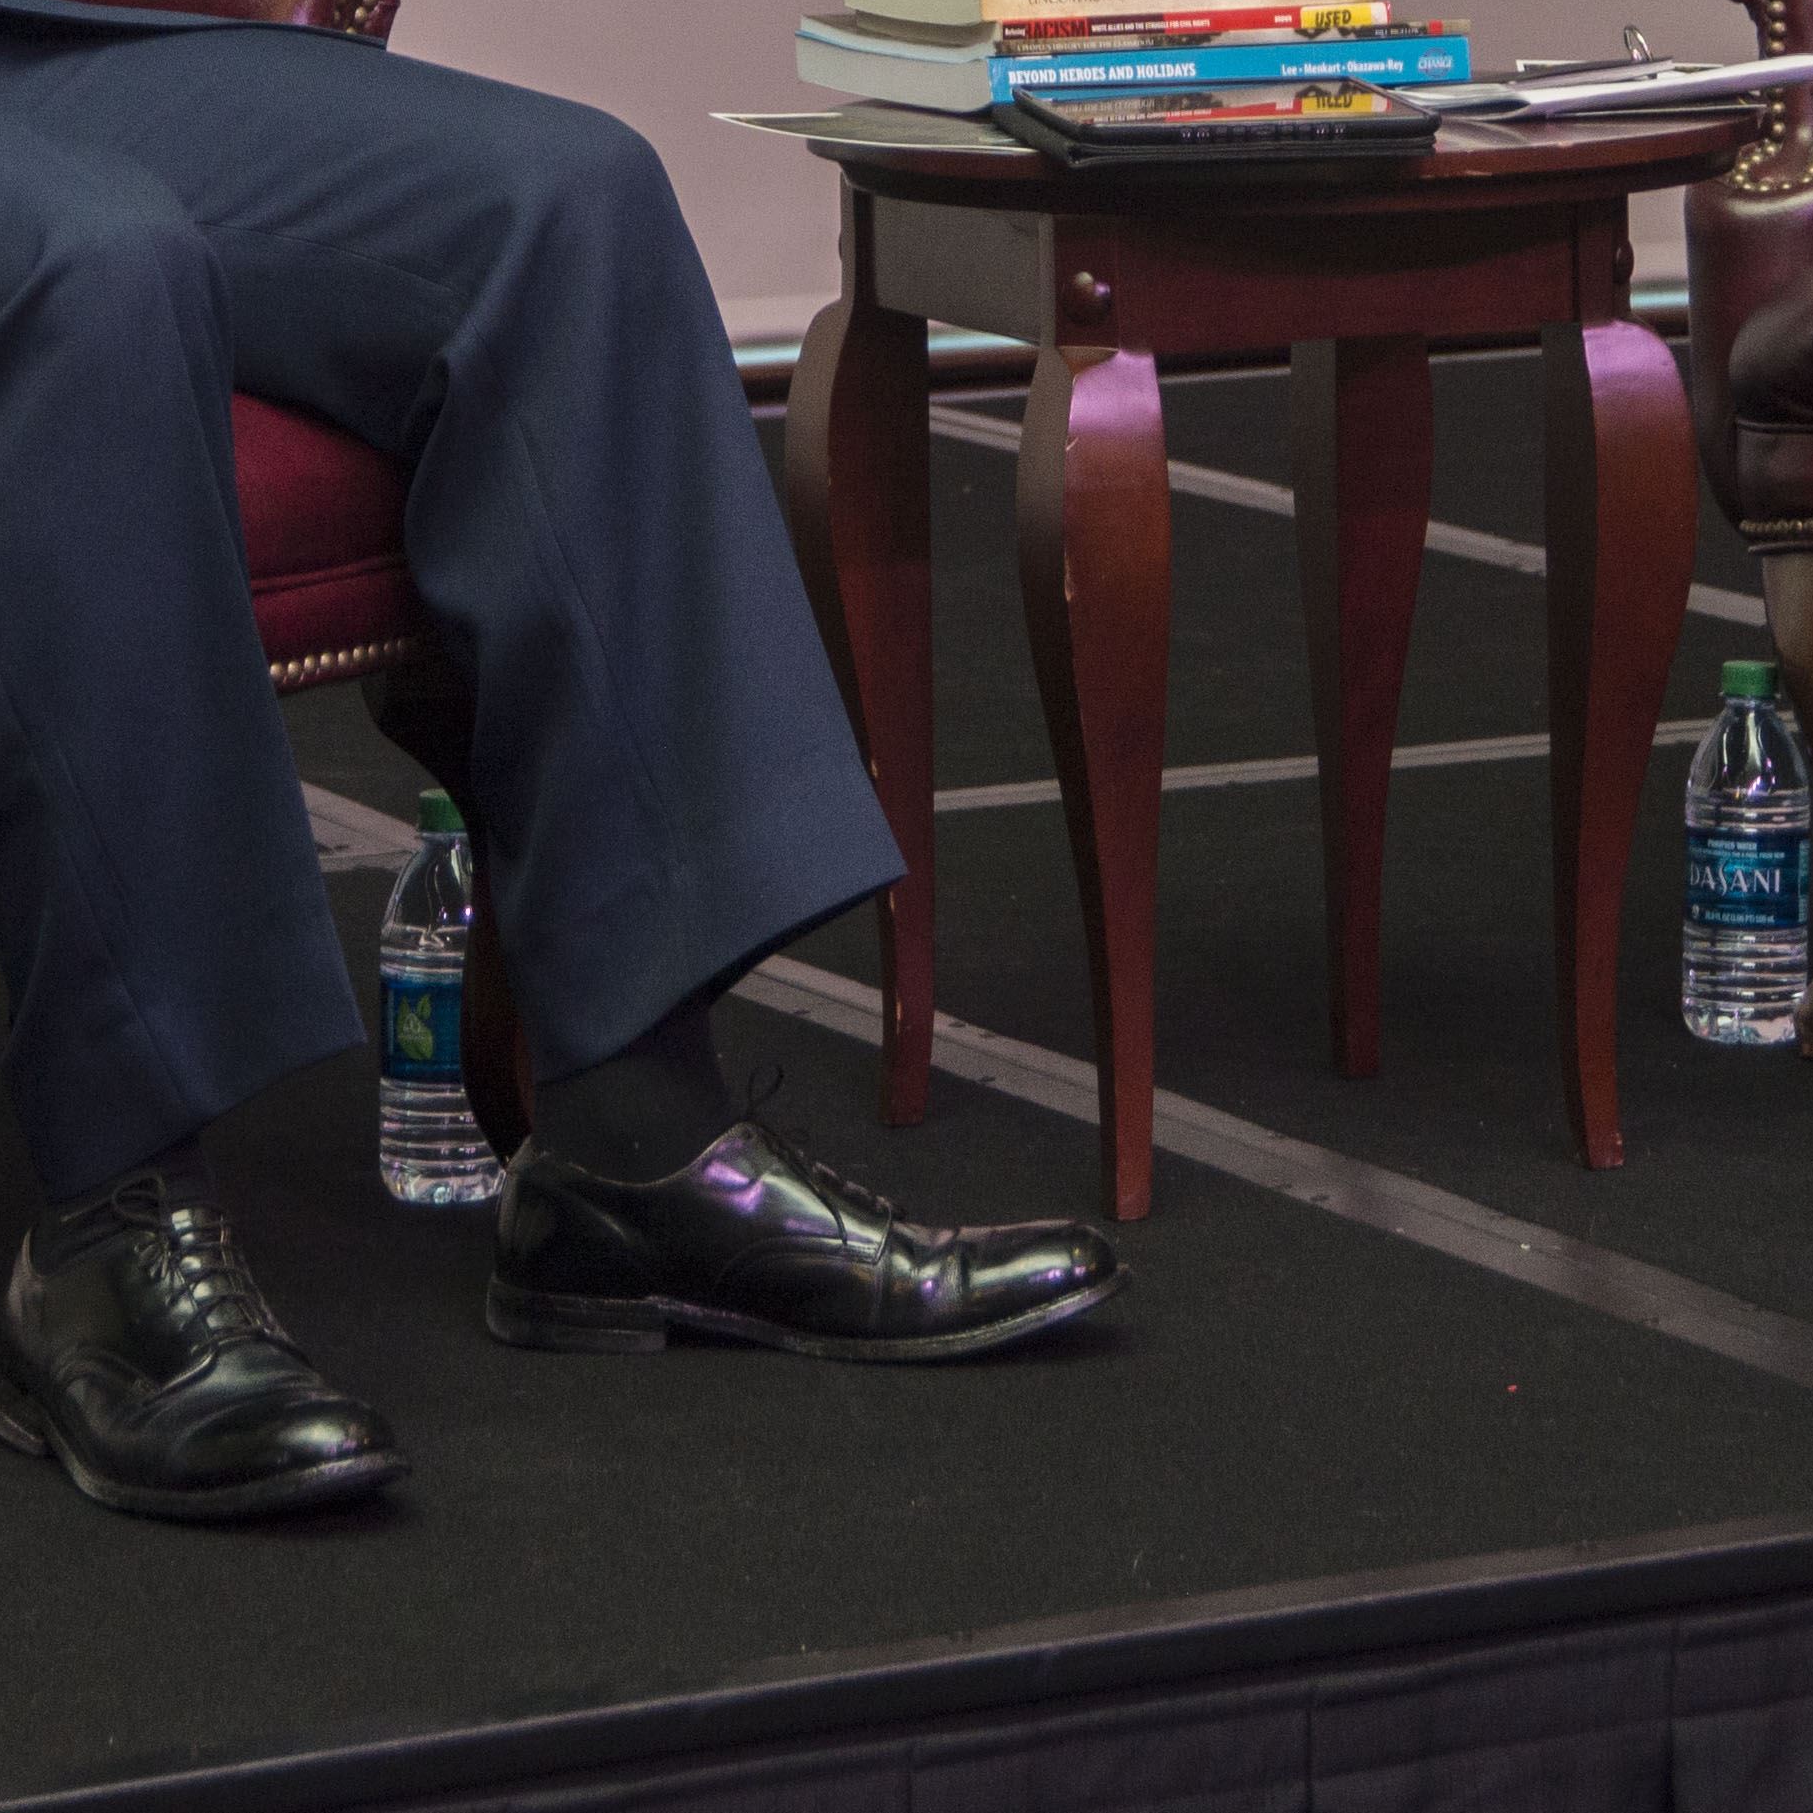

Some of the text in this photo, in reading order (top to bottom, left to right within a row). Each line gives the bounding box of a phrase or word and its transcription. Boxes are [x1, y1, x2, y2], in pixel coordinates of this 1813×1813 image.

[1315, 10, 1352, 27] USED
[1025, 20, 1086, 38] RACISM
[1008, 63, 1197, 84] BEYOND HEROES AND HOLIDAYS
[1281, 59, 1404, 76] Lee Menkart Okazawa-Rey
[1689, 858, 1781, 897] DASANI
